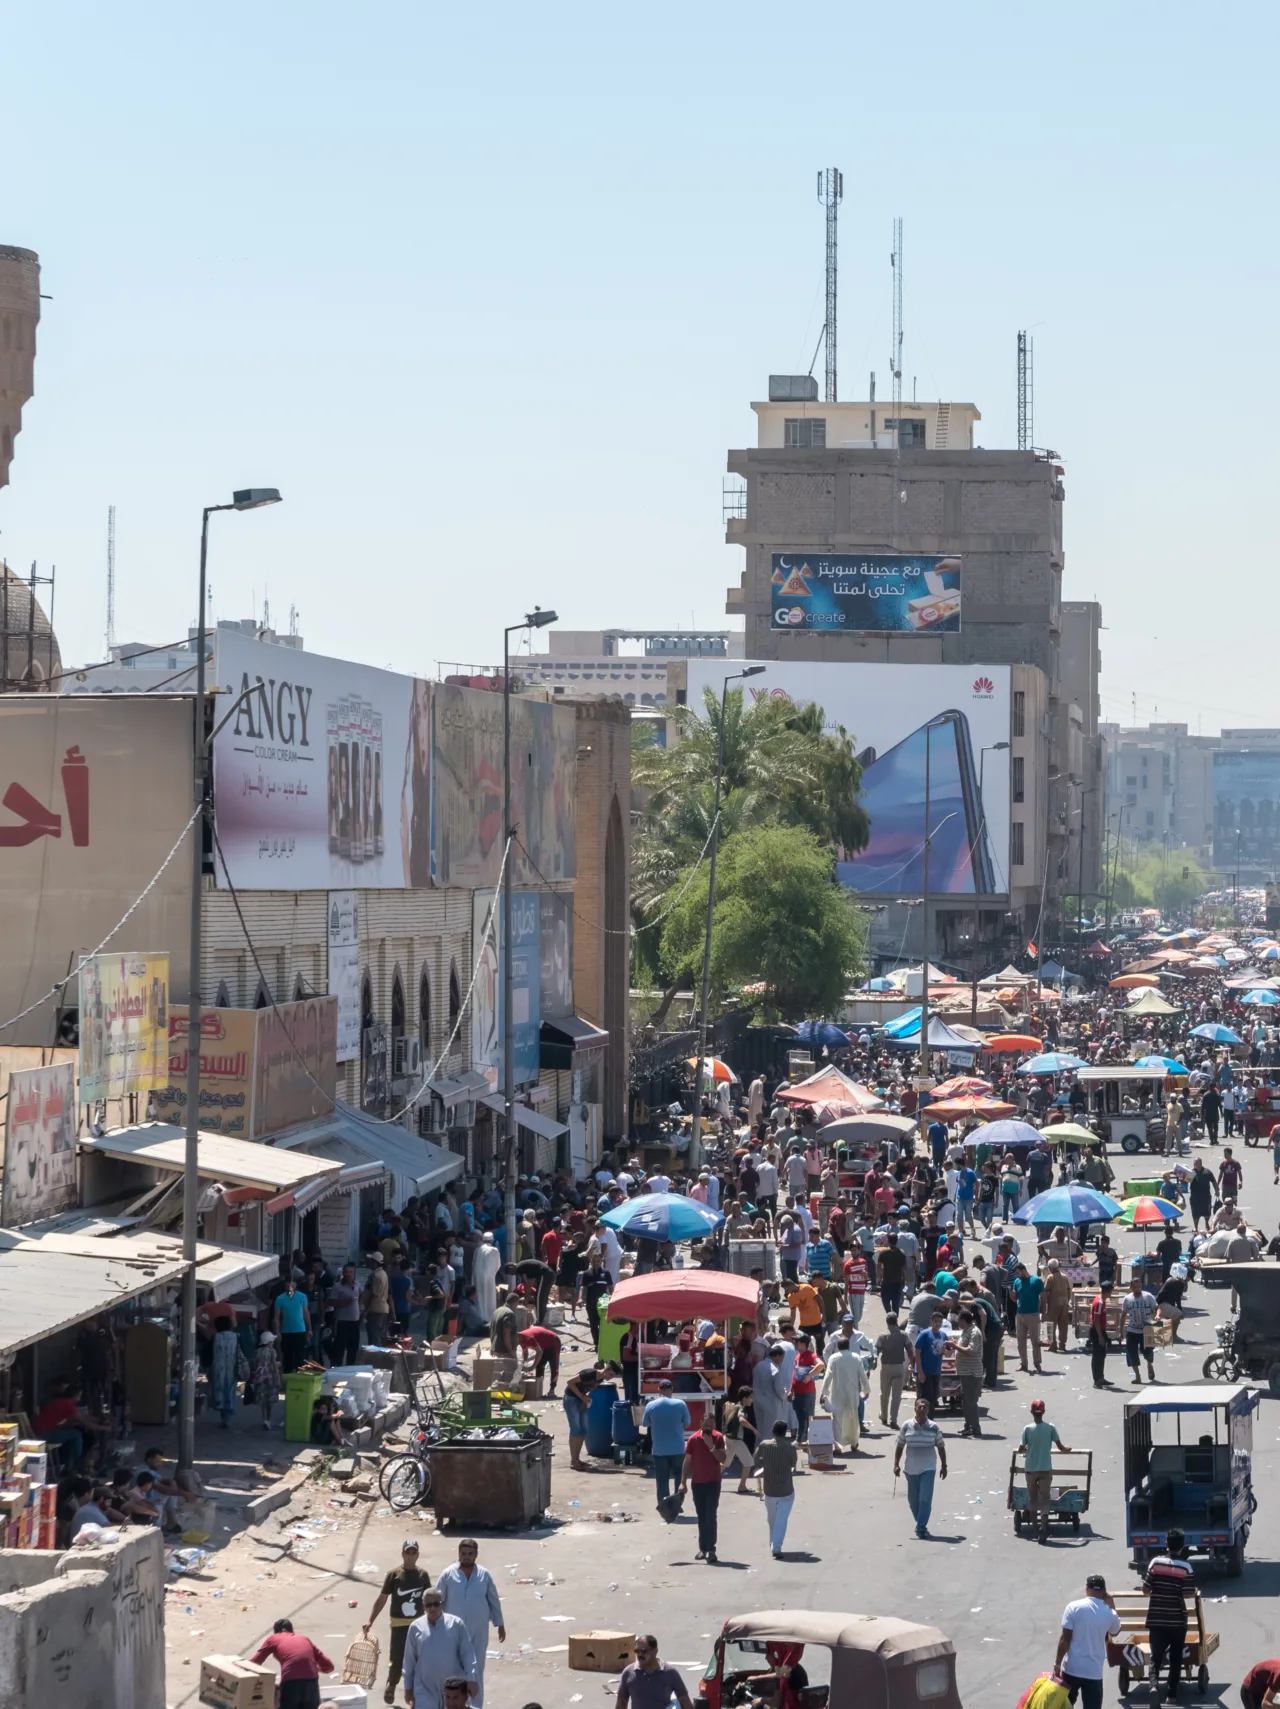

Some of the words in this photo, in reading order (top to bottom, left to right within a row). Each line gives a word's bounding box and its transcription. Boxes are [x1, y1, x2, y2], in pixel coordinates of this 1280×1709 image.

[817, 561, 857, 578] سويتز
[860, 562, 900, 579] عجينة
[902, 566, 921, 579] مع
[833, 582, 866, 595] لمتنا
[805, 611, 846, 623] create
[233, 672, 313, 747] ANGY
[254, 745, 276, 760] COLOR
[276, 748, 298, 762] CREAM
